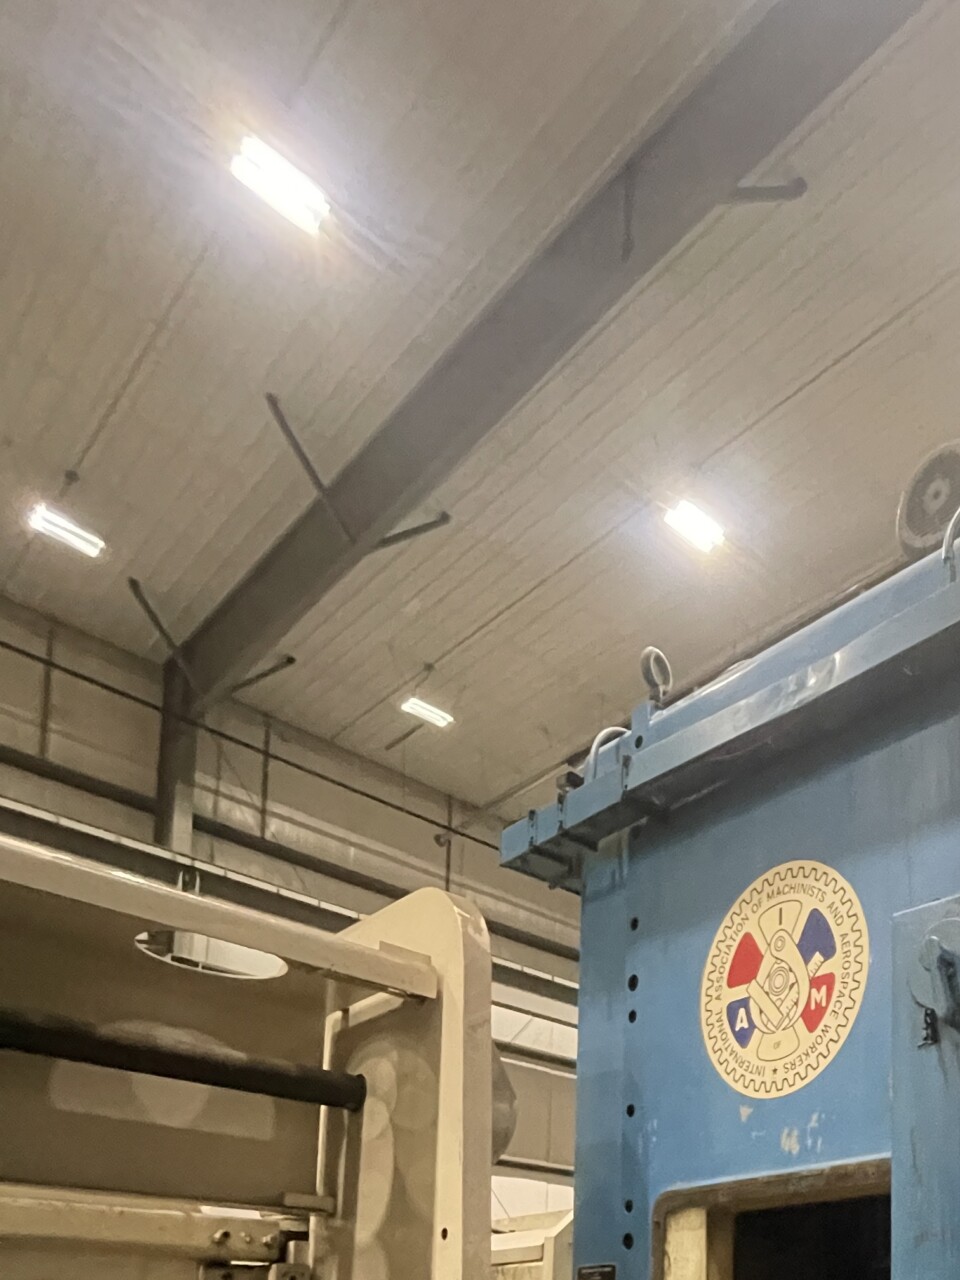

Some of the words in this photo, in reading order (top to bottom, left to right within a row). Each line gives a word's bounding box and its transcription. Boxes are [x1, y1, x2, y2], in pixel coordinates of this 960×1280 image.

[751, 897, 763, 914] OF
[767, 882, 827, 903] MACHINISTS
[827, 901, 844, 927] AND
[714, 914, 750, 1001] ASSOCIATION
[830, 933, 851, 1020] AEROSPACE
[810, 986, 827, 1010] M
[735, 1008, 749, 1031] A
[715, 1007, 765, 1076] INTERNATIONAL
[783, 1025, 832, 1074] WORKERS
